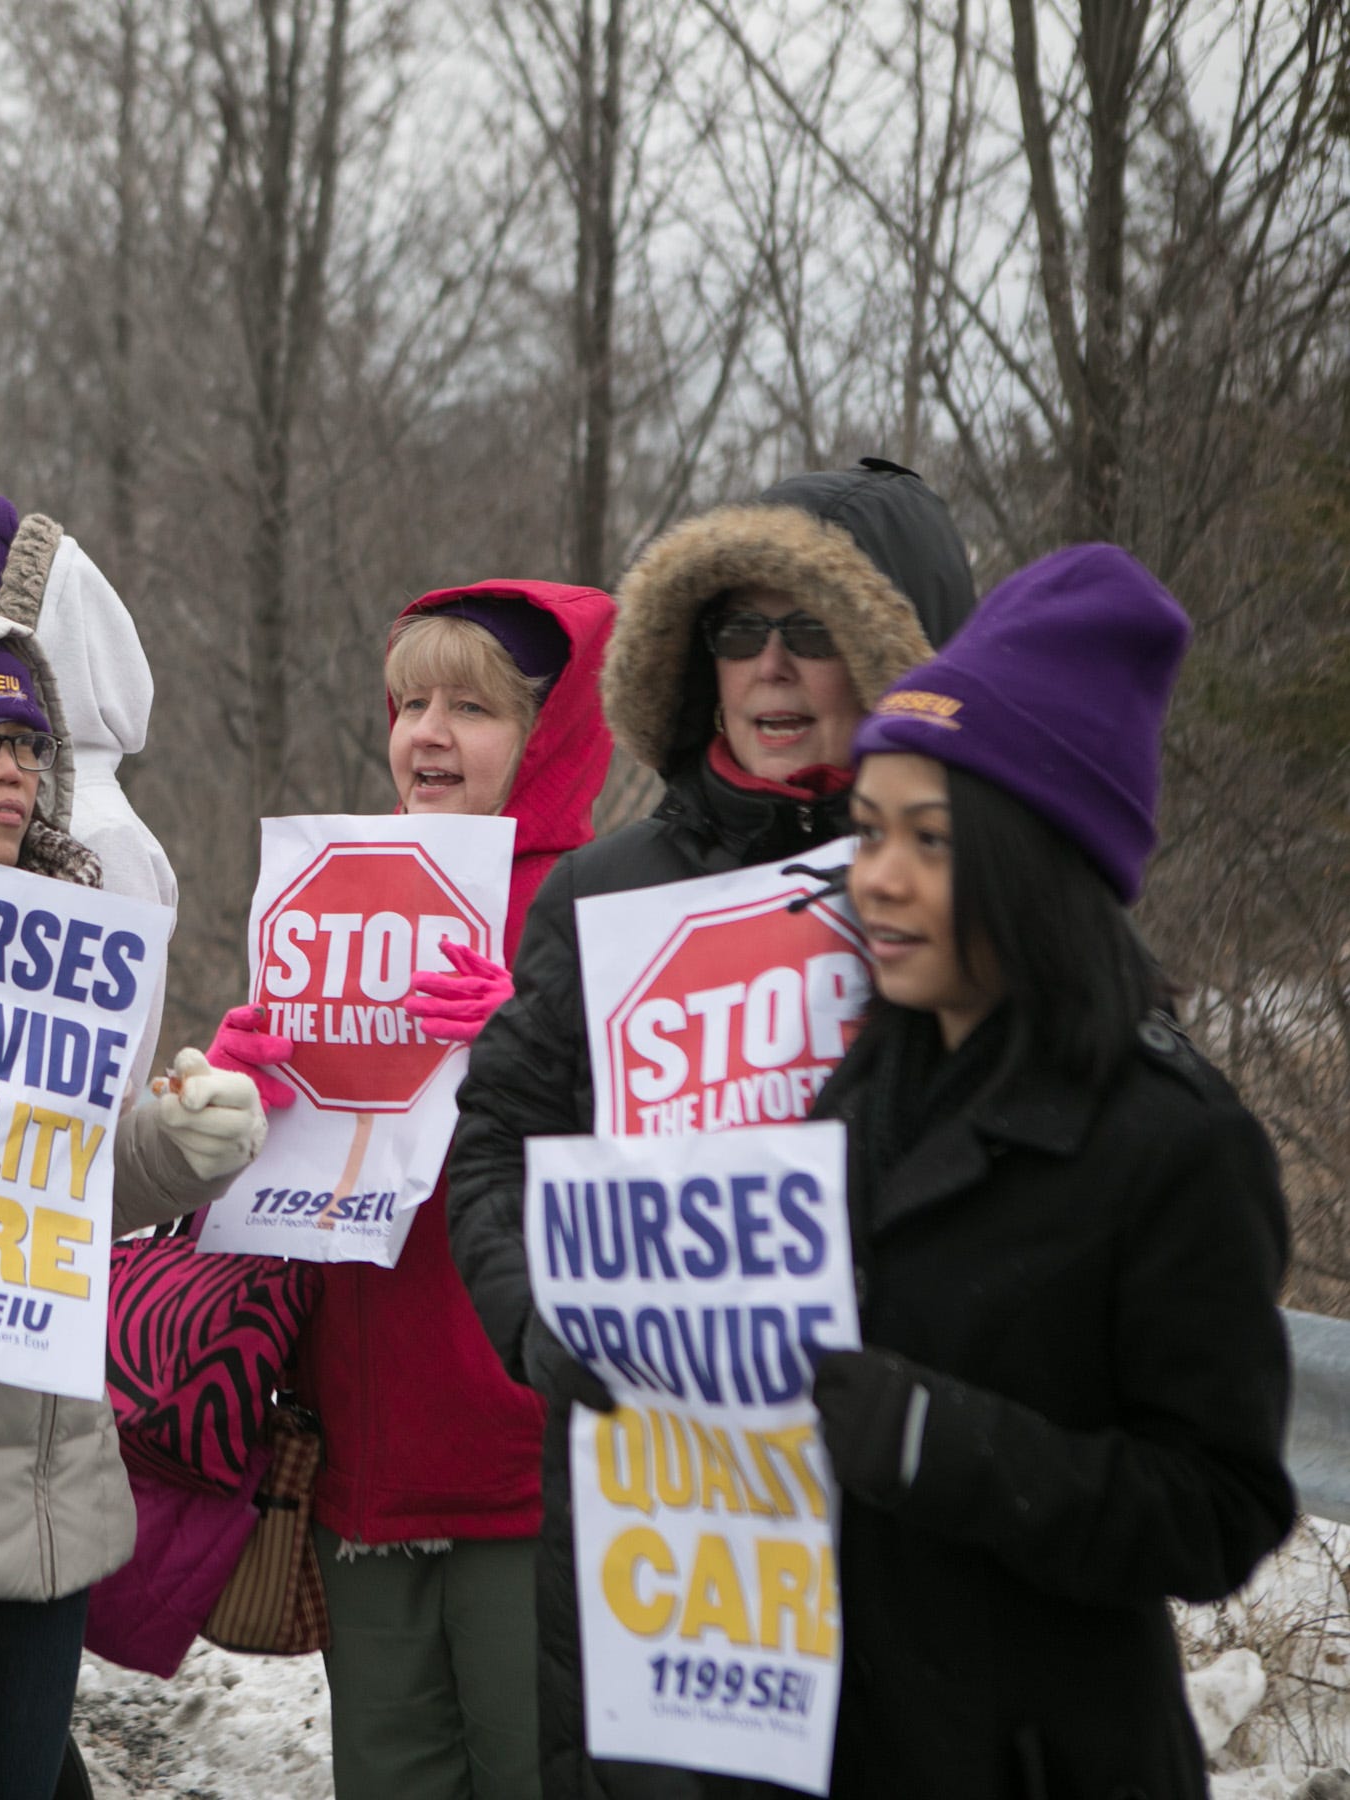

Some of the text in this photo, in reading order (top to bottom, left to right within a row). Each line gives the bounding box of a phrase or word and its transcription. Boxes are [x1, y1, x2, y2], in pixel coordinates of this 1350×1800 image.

[268, 1002, 319, 1043] THE
[626, 951, 872, 1103] STOP
[543, 1172, 826, 1281] NURSES
[596, 1405, 828, 1520] QUALIT
